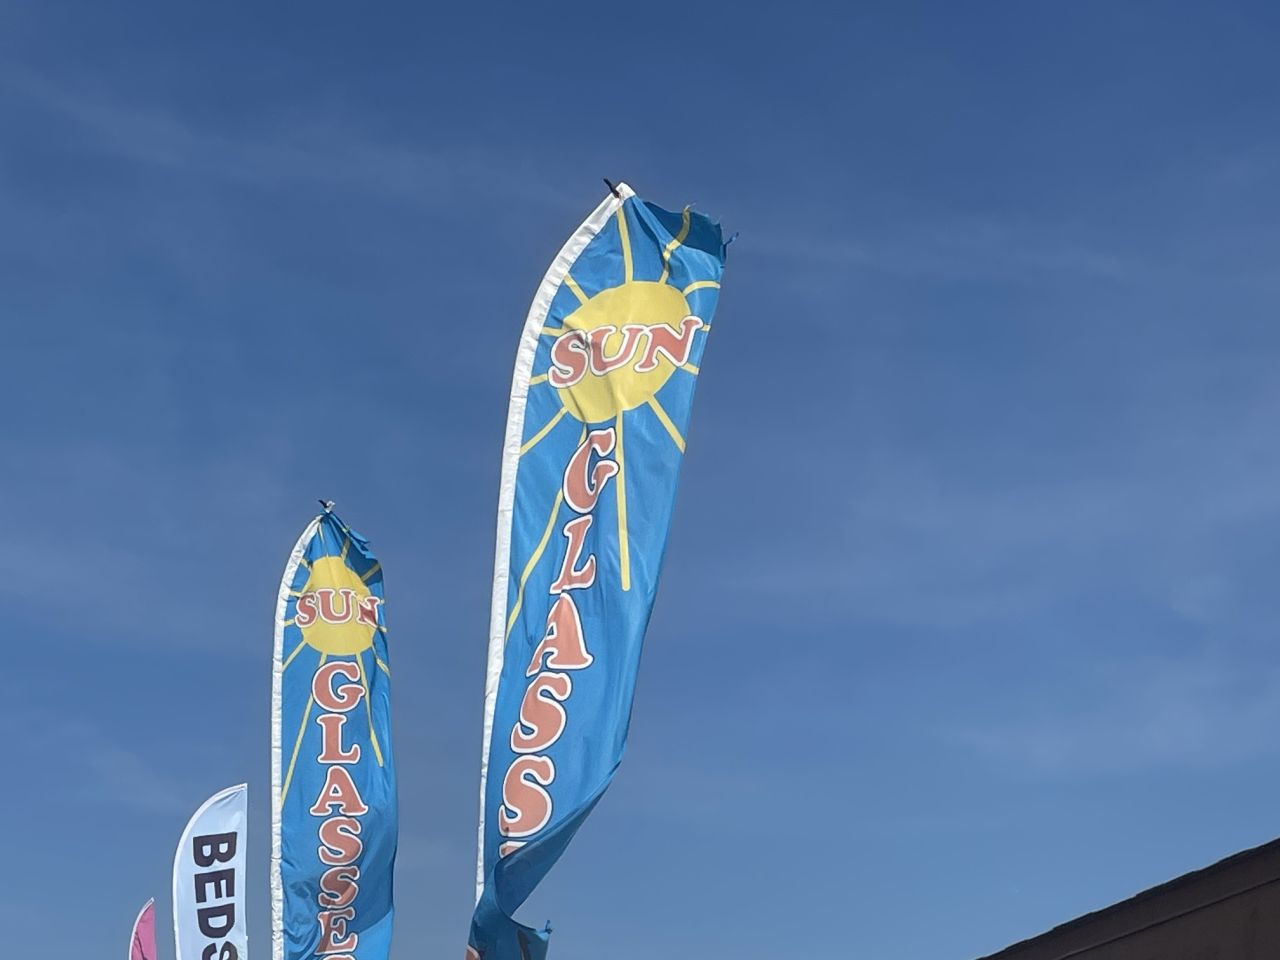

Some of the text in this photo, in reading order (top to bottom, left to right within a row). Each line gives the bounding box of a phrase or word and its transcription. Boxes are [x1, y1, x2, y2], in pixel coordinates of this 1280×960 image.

[548, 316, 703, 388] SUN
[296, 588, 379, 628] SUN
[499, 427, 620, 858] GLASS
